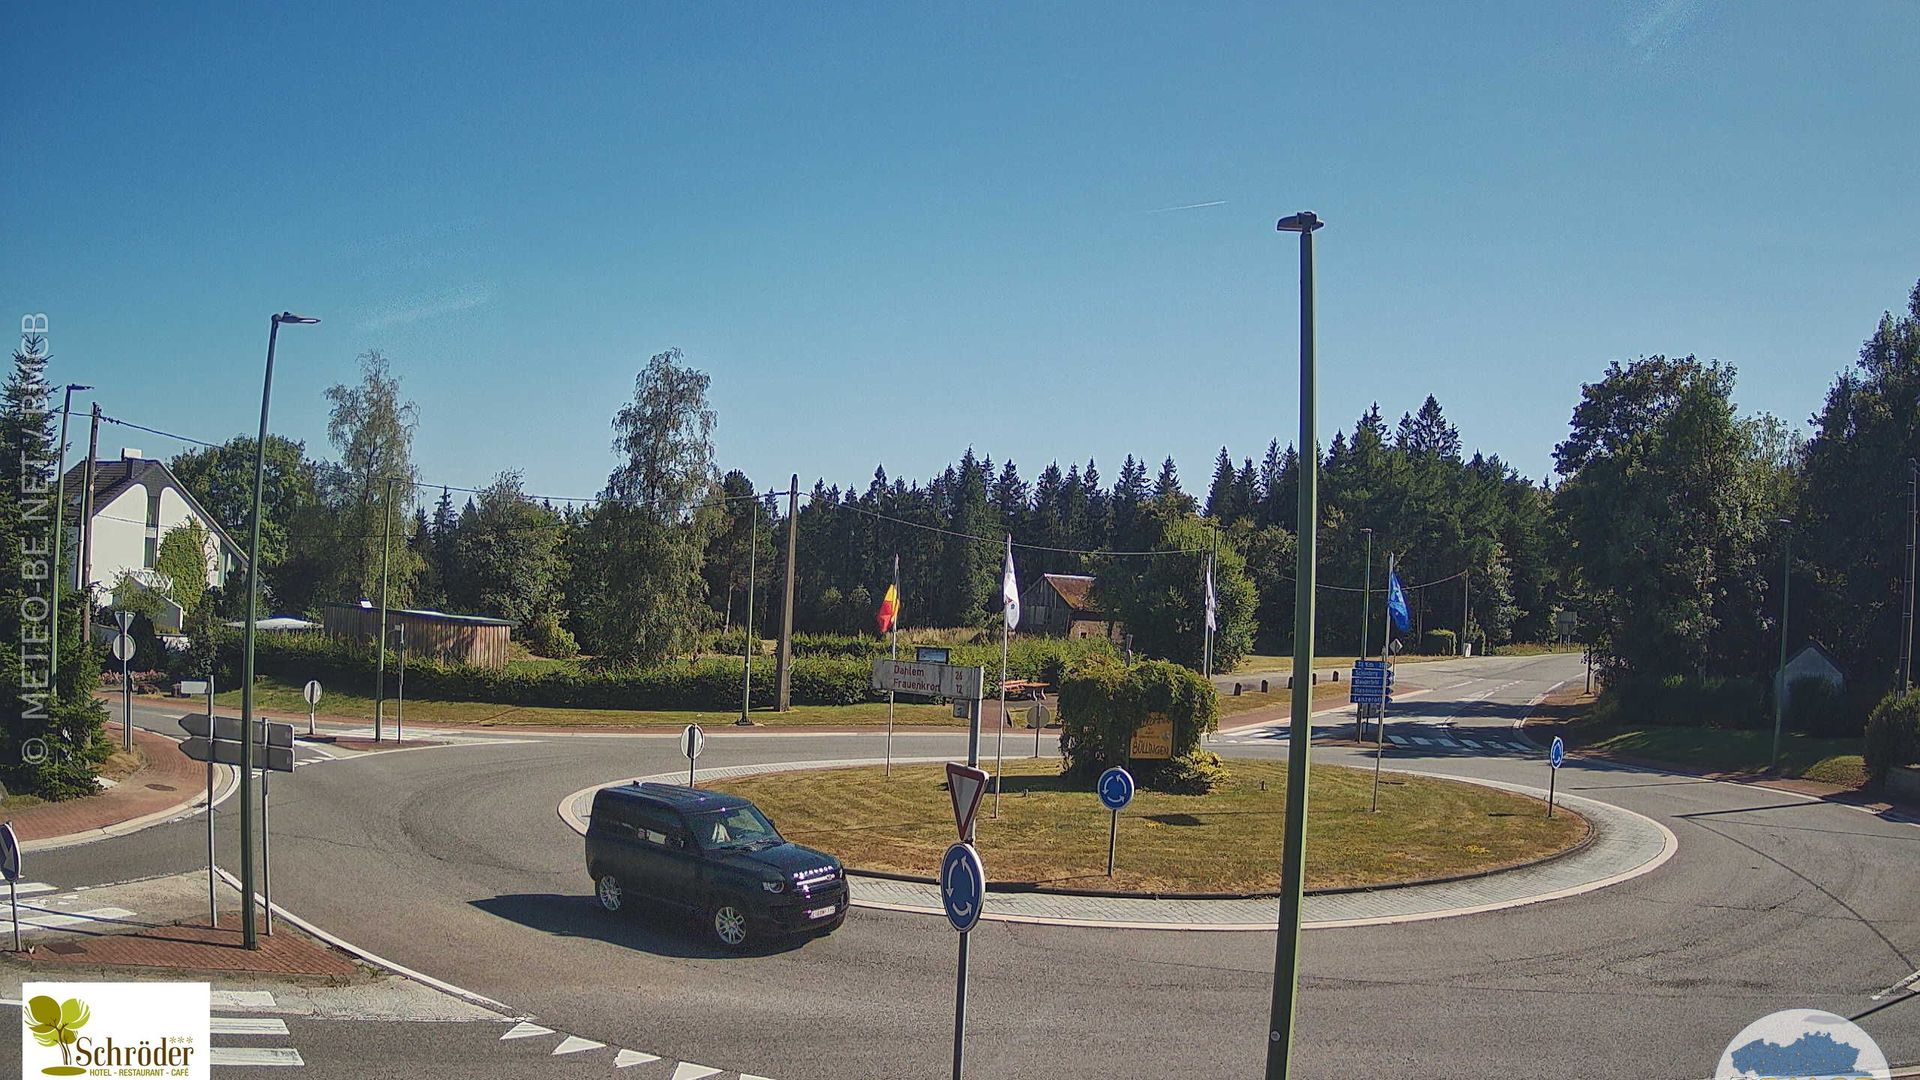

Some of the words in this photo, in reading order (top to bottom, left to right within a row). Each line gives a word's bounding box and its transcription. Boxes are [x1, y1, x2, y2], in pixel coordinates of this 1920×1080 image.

[893, 664, 925, 677] Dahlem
[893, 678, 940, 692] Frauenkron
[956, 684, 963, 694] 12
